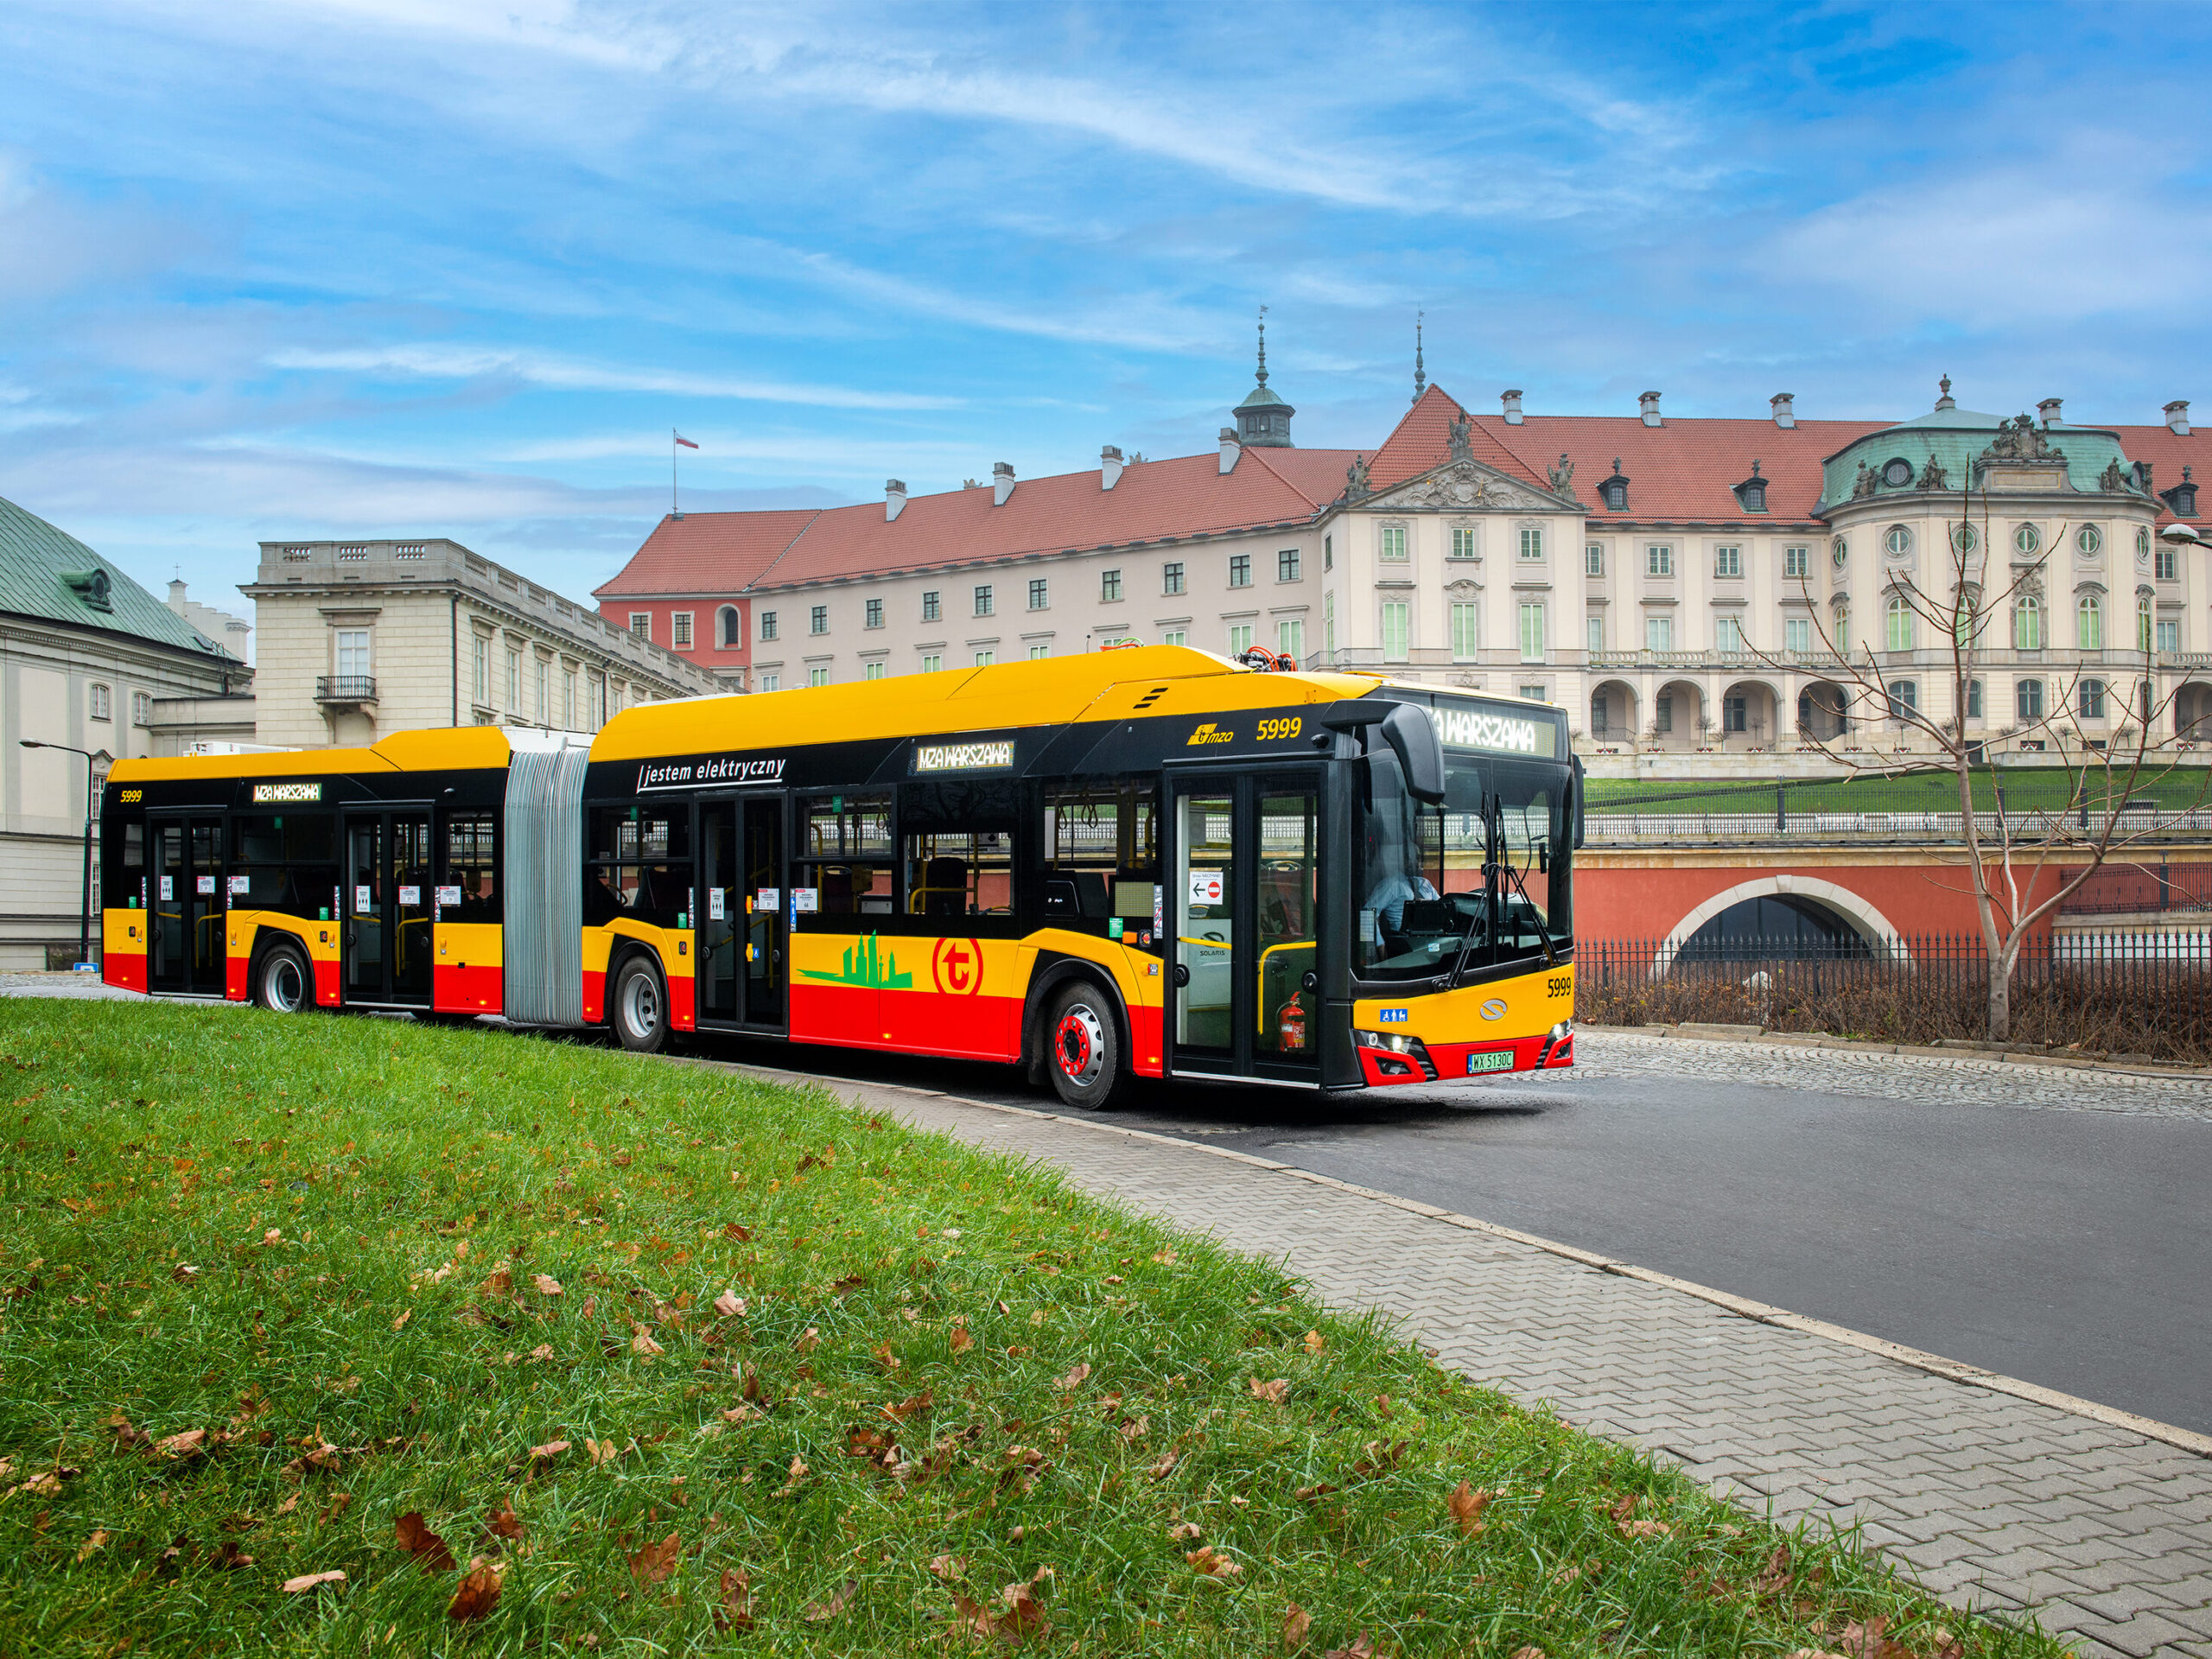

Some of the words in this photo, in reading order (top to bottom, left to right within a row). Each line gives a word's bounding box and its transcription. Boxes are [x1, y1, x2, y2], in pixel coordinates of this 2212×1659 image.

[1255, 716, 1302, 741] 5999
[1446, 710, 1535, 753] WARSZAWA
[919, 747, 944, 768] MZA
[944, 743, 1010, 766] WARSZAWA
[644, 765, 691, 787] jestem
[696, 759, 786, 781] elektryczny
[120, 790, 143, 803] 5999
[255, 785, 273, 801] MZA
[273, 784, 319, 800] WARSZAWA
[1548, 976, 1572, 998] 5999
[1473, 1055, 1484, 1070] WX
[1487, 1052, 1512, 1068] 5130C
